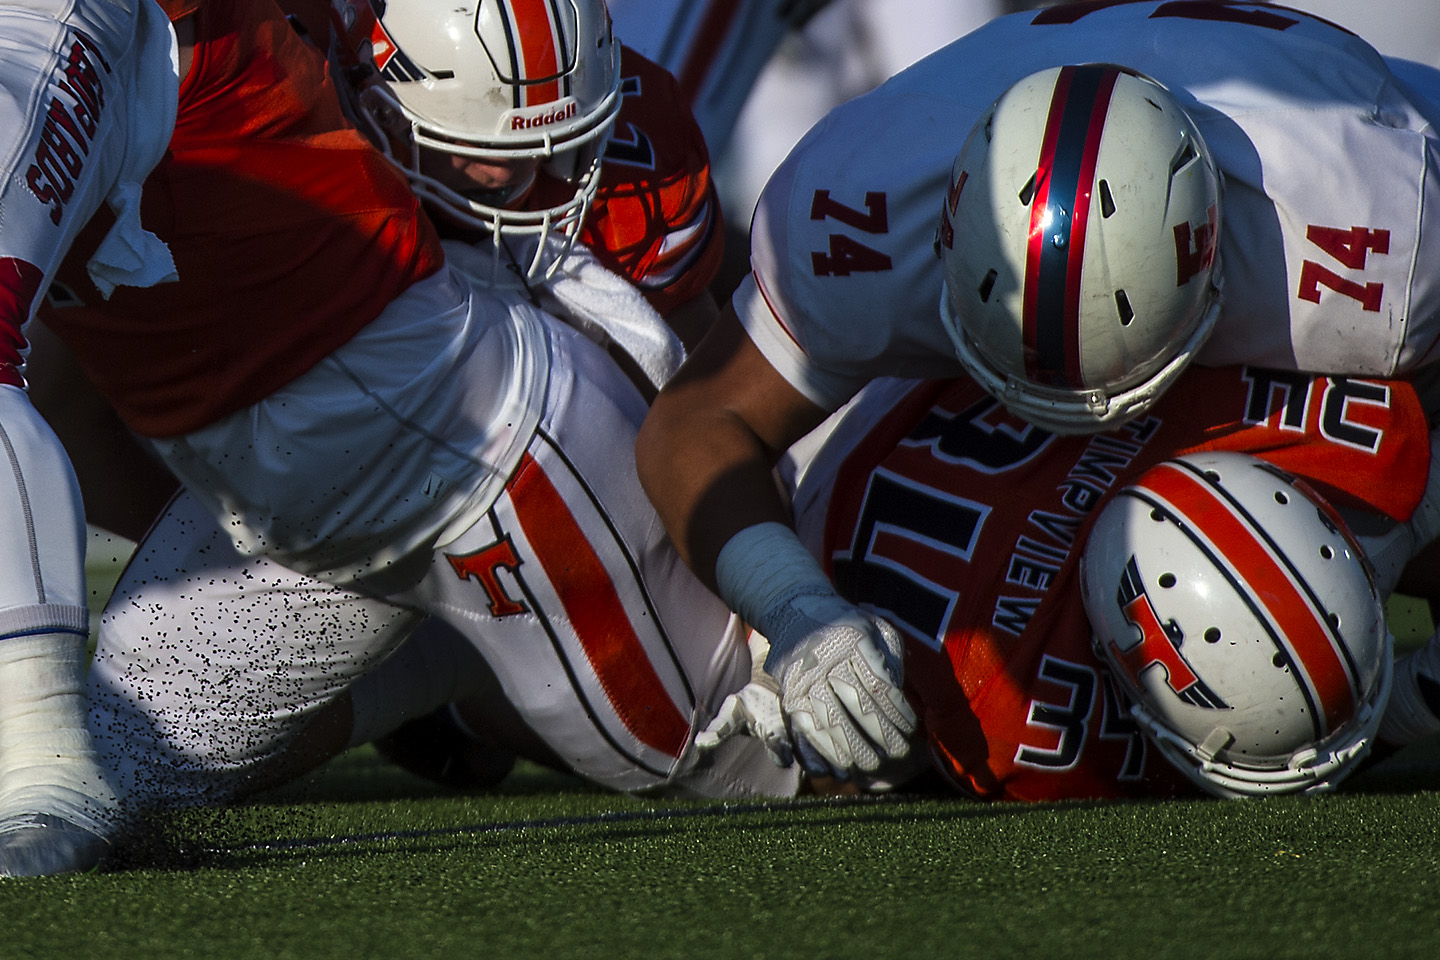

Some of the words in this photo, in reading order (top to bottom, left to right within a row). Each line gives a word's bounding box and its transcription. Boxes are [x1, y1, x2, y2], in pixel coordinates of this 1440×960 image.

[511, 102, 576, 131] Riddell
[810, 189, 893, 278] 74
[1298, 224, 1392, 313] 74
[992, 416, 1162, 637] TIMPVIEW
[443, 532, 532, 618] T
